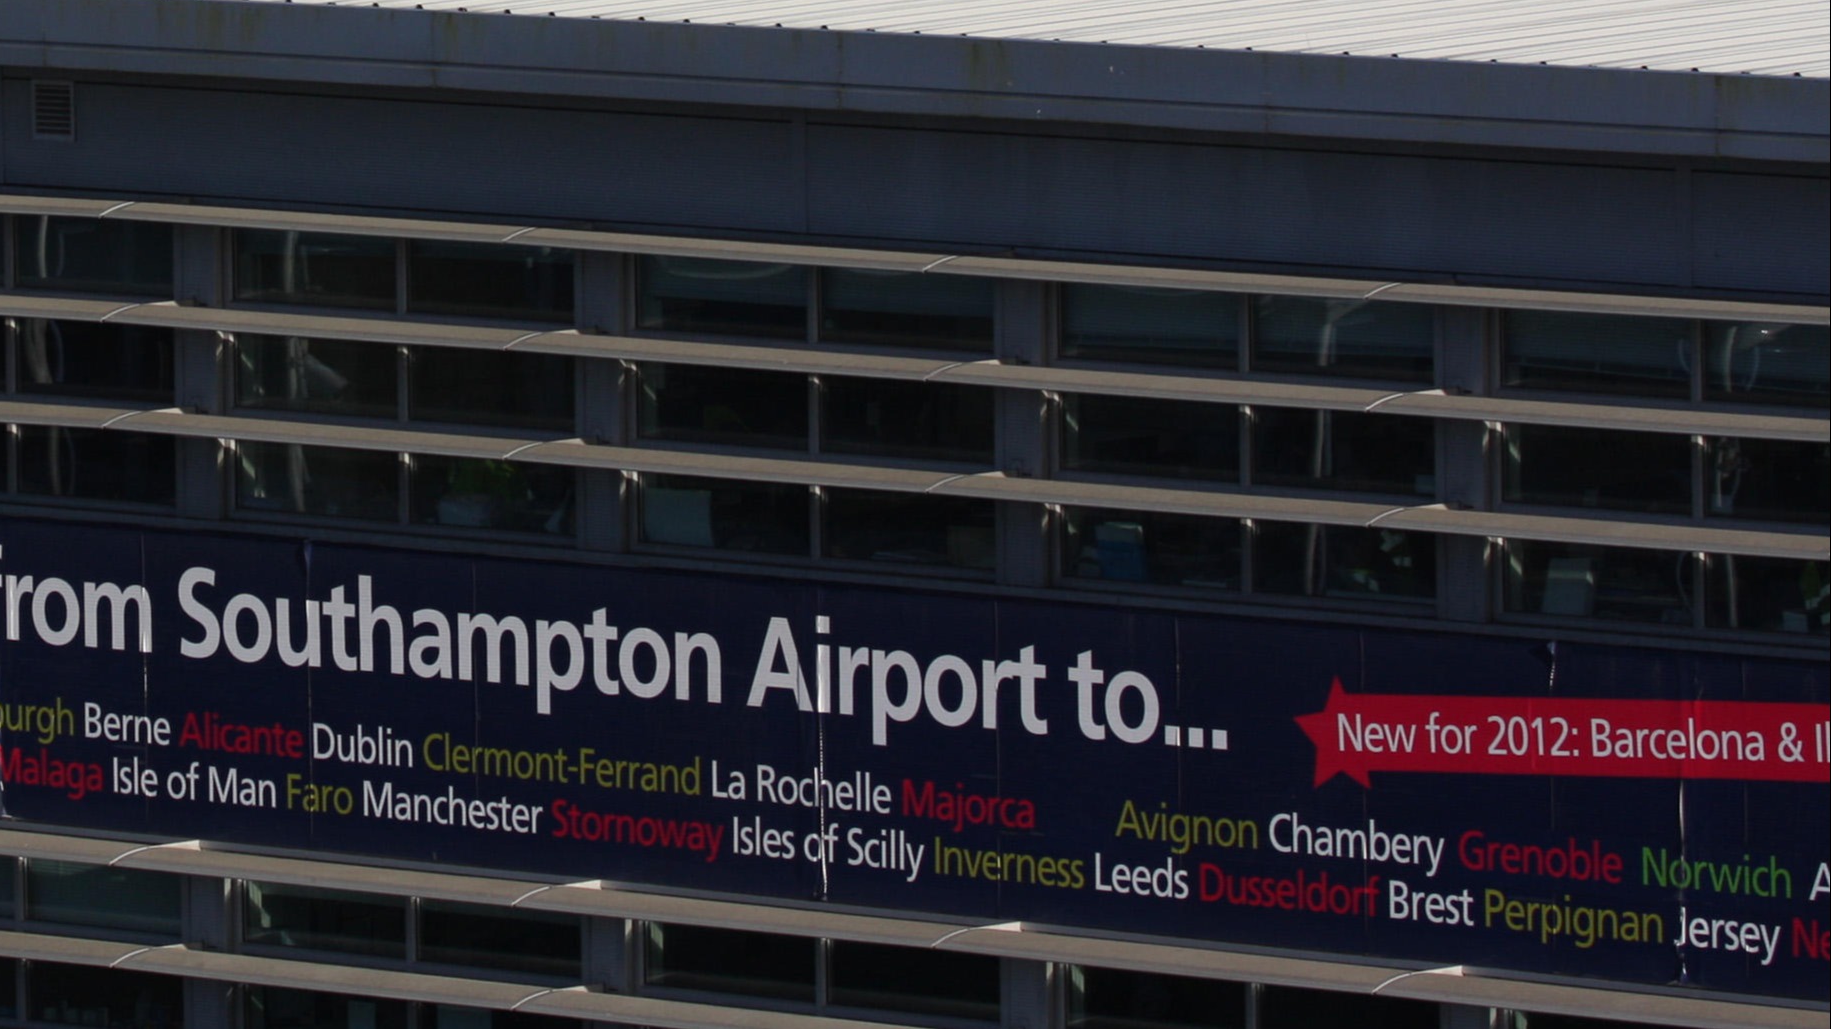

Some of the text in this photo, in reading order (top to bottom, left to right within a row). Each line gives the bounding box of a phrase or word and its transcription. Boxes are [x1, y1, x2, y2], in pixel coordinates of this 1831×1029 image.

[178, 566, 723, 715] Southampton
[747, 614, 1048, 746] Airport
[1068, 649, 1229, 751] to...
[83, 703, 171, 748] Berne
[180, 712, 304, 760] Alicante
[313, 722, 415, 769] Dublin
[423, 733, 701, 796] Clermont-Ferrand
[711, 760, 747, 800] La
[757, 764, 892, 814] Rochelle
[902, 778, 1035, 832] Majorca
[1337, 713, 1416, 754] New
[1425, 711, 1477, 755] for
[1487, 715, 1580, 758] 2012:
[1591, 717, 1765, 764] Barcelona
[1777, 722, 1805, 763] &
[113, 757, 158, 799] Isle
[167, 763, 200, 802] of
[209, 767, 277, 809] Man
[287, 773, 354, 816] Faro
[363, 781, 543, 835] Manchester
[551, 798, 724, 862] Stornoway
[733, 816, 795, 860] Isles
[804, 823, 839, 863] of
[847, 827, 925, 882] Scilly
[935, 836, 1085, 891] Inverness
[1095, 852, 1190, 901] Leeds
[1199, 863, 1381, 918] Dusseldorf
[1389, 879, 1474, 928] Brest
[1484, 889, 1664, 950] Perpignan
[1674, 905, 1781, 966] Jersey
[1115, 799, 1259, 854] Avignon
[1269, 812, 1445, 877] Chambery
[1459, 830, 1624, 884] Grenoble
[1642, 846, 1793, 899] Norwich
